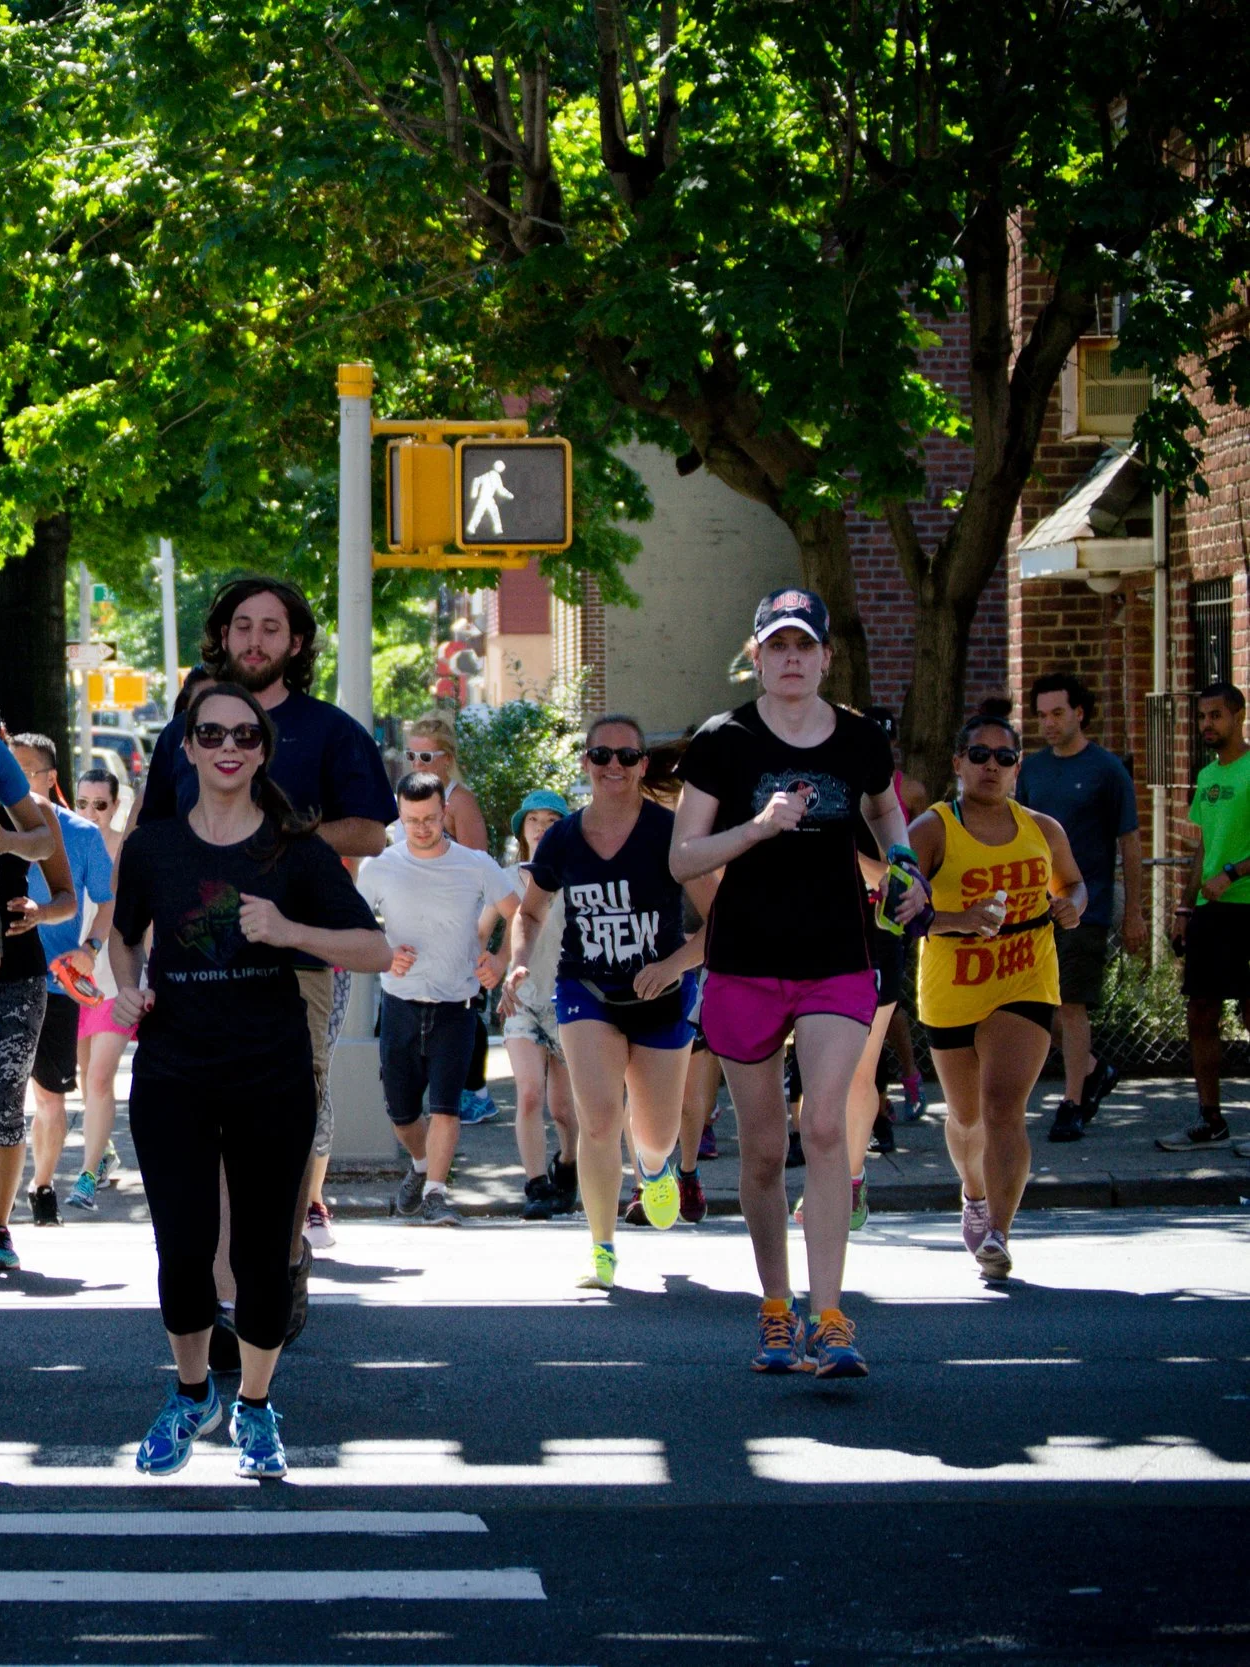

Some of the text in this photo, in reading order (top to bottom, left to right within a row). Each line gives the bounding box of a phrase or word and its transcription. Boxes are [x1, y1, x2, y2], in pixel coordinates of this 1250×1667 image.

[772, 590, 812, 614] USA
[960, 856, 1049, 897] SHE
[575, 910, 660, 967] CREW
[191, 968, 229, 981] YORK
